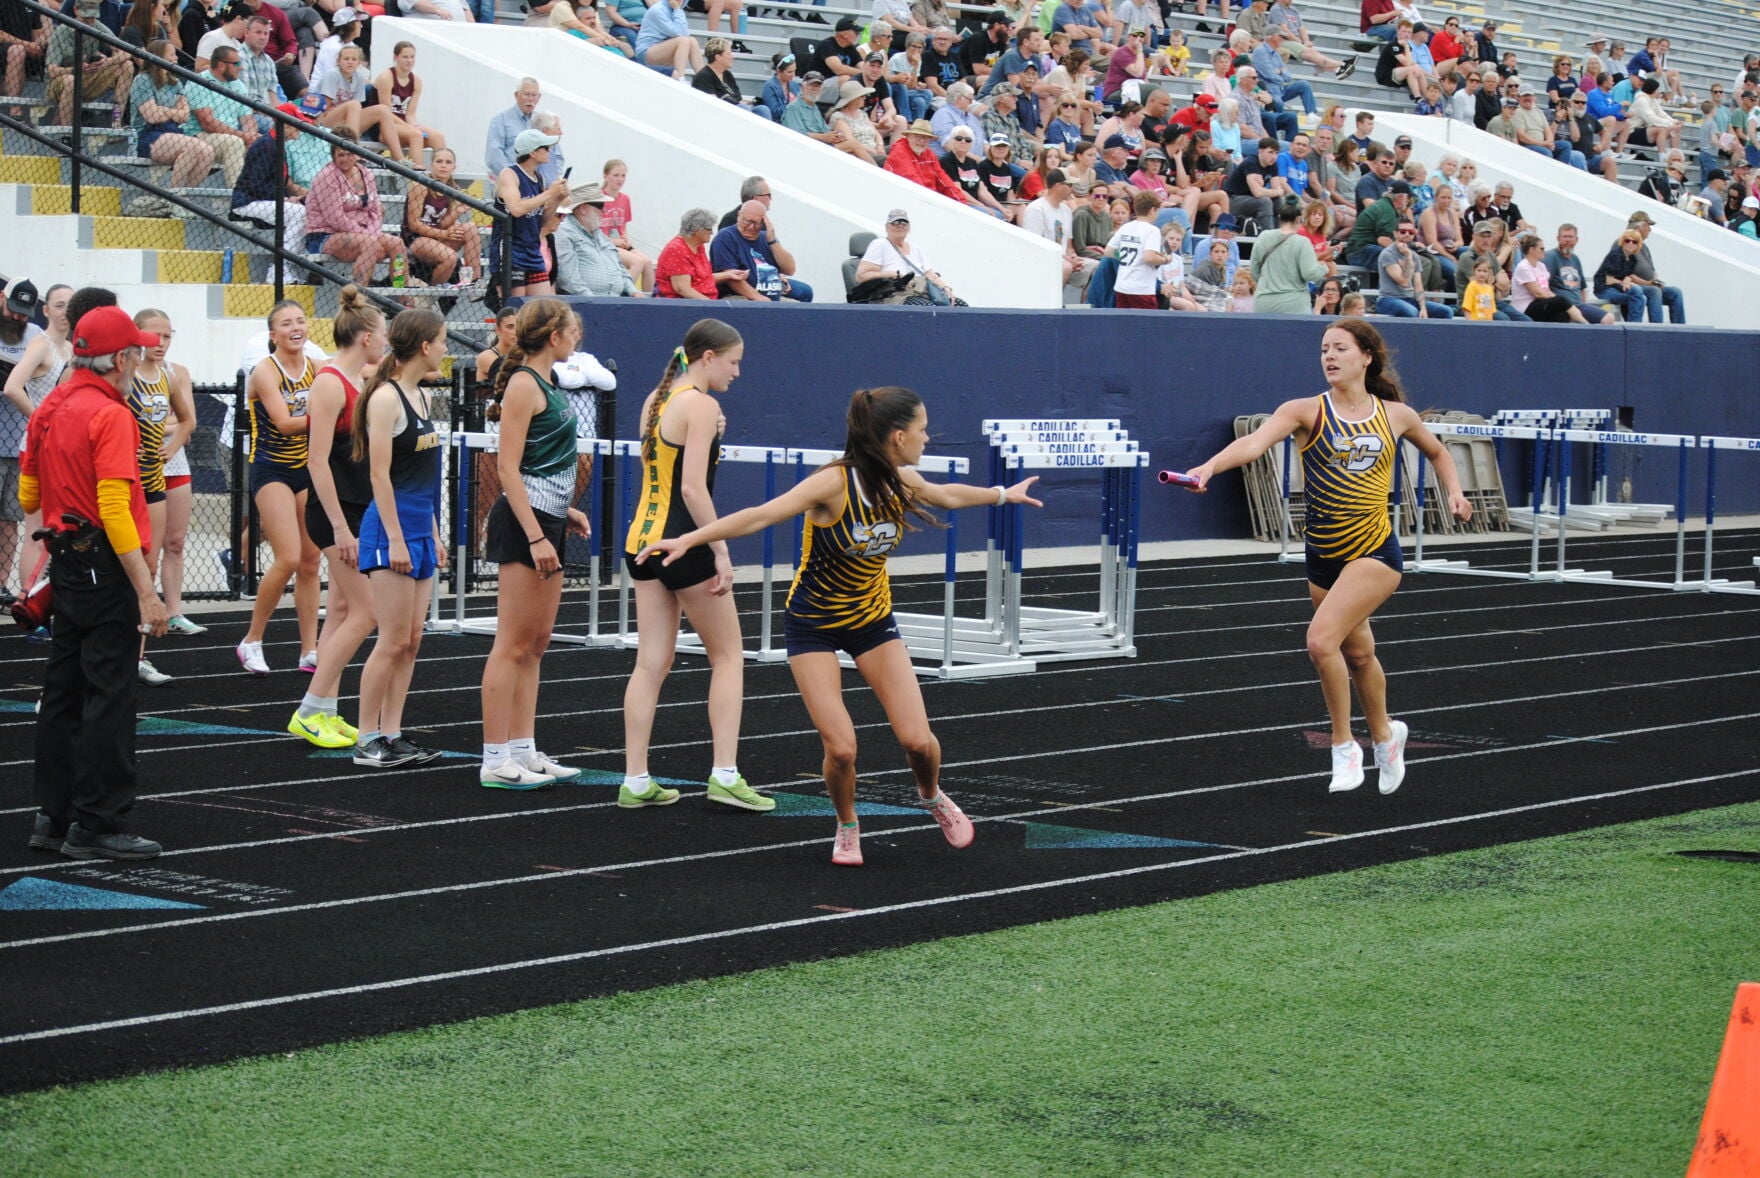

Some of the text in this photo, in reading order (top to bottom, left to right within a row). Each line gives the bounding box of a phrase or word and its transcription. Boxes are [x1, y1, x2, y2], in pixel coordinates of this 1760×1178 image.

[1119, 247, 1138, 266] 27
[1031, 421, 1077, 431] CADILLAC
[1456, 425, 1504, 436] CADILLAC
[1039, 432, 1085, 442] CADILLAC
[1599, 432, 1647, 443] CADILLAC
[1050, 443, 1095, 453] CADILLAC
[1056, 454, 1104, 466] CADILLAC
